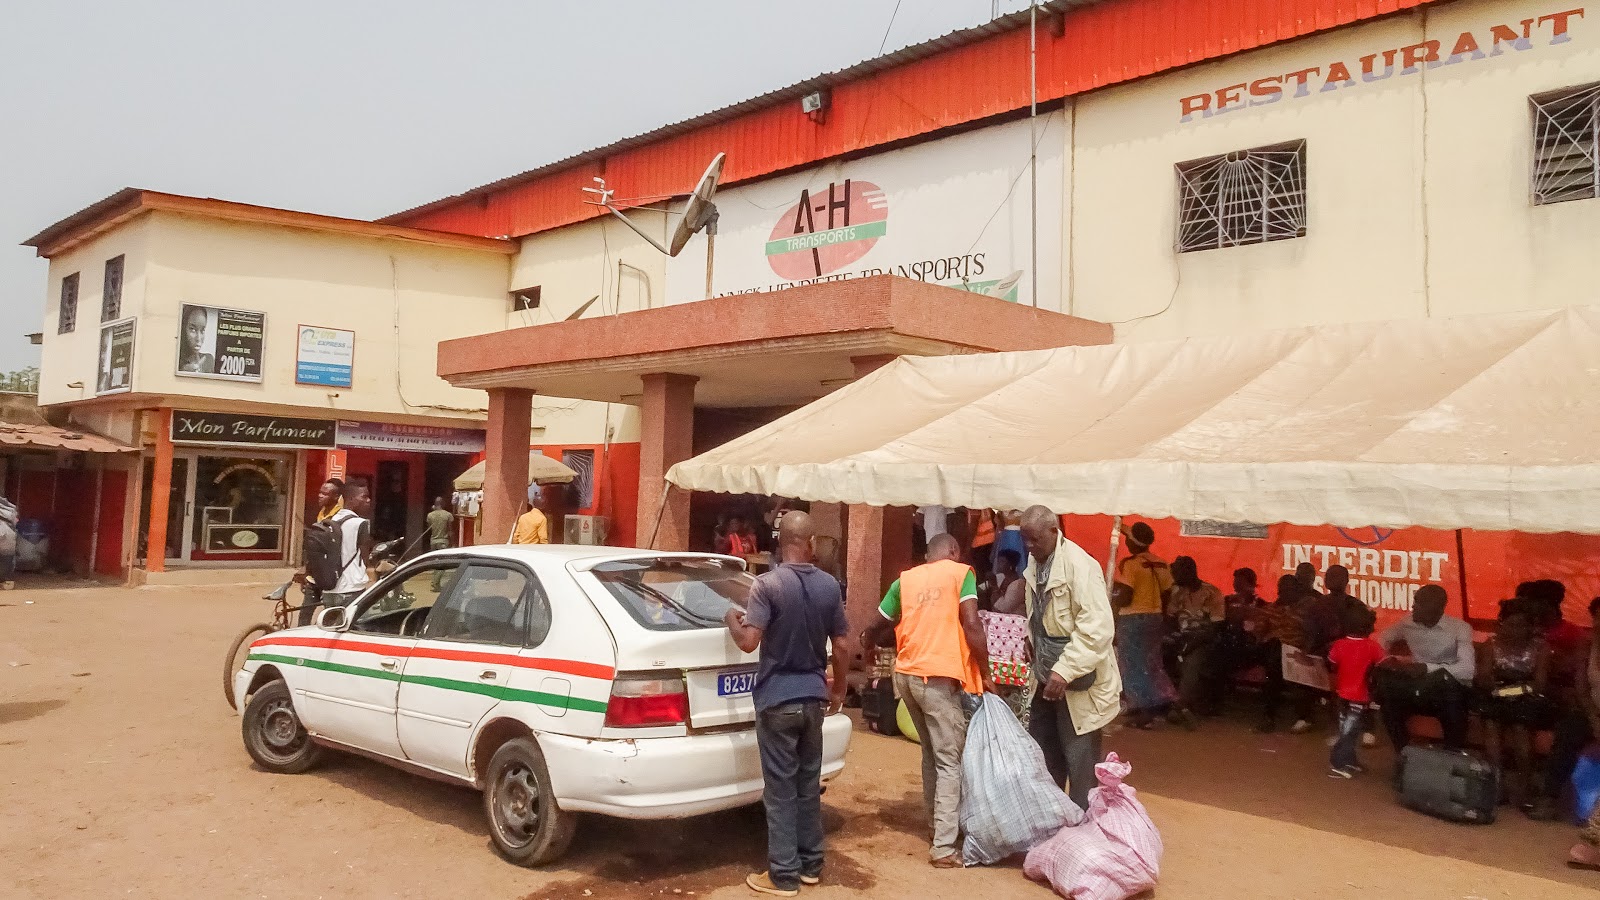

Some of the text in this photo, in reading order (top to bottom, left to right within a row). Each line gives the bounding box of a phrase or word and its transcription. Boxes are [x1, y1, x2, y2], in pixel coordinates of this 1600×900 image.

[1179, 7, 1585, 124] RESTAURANT
[793, 178, 851, 236] A-H
[786, 226, 857, 251] TRANSPORTS
[861, 252, 986, 283] NSPORTS
[317, 340, 347, 348] EXPRESS
[219, 354, 245, 375] 2000
[179, 417, 326, 441] Mon Parfumeur
[1282, 543, 1449, 582] INTERDIT
[1313, 575, 1426, 612] STIONNE
